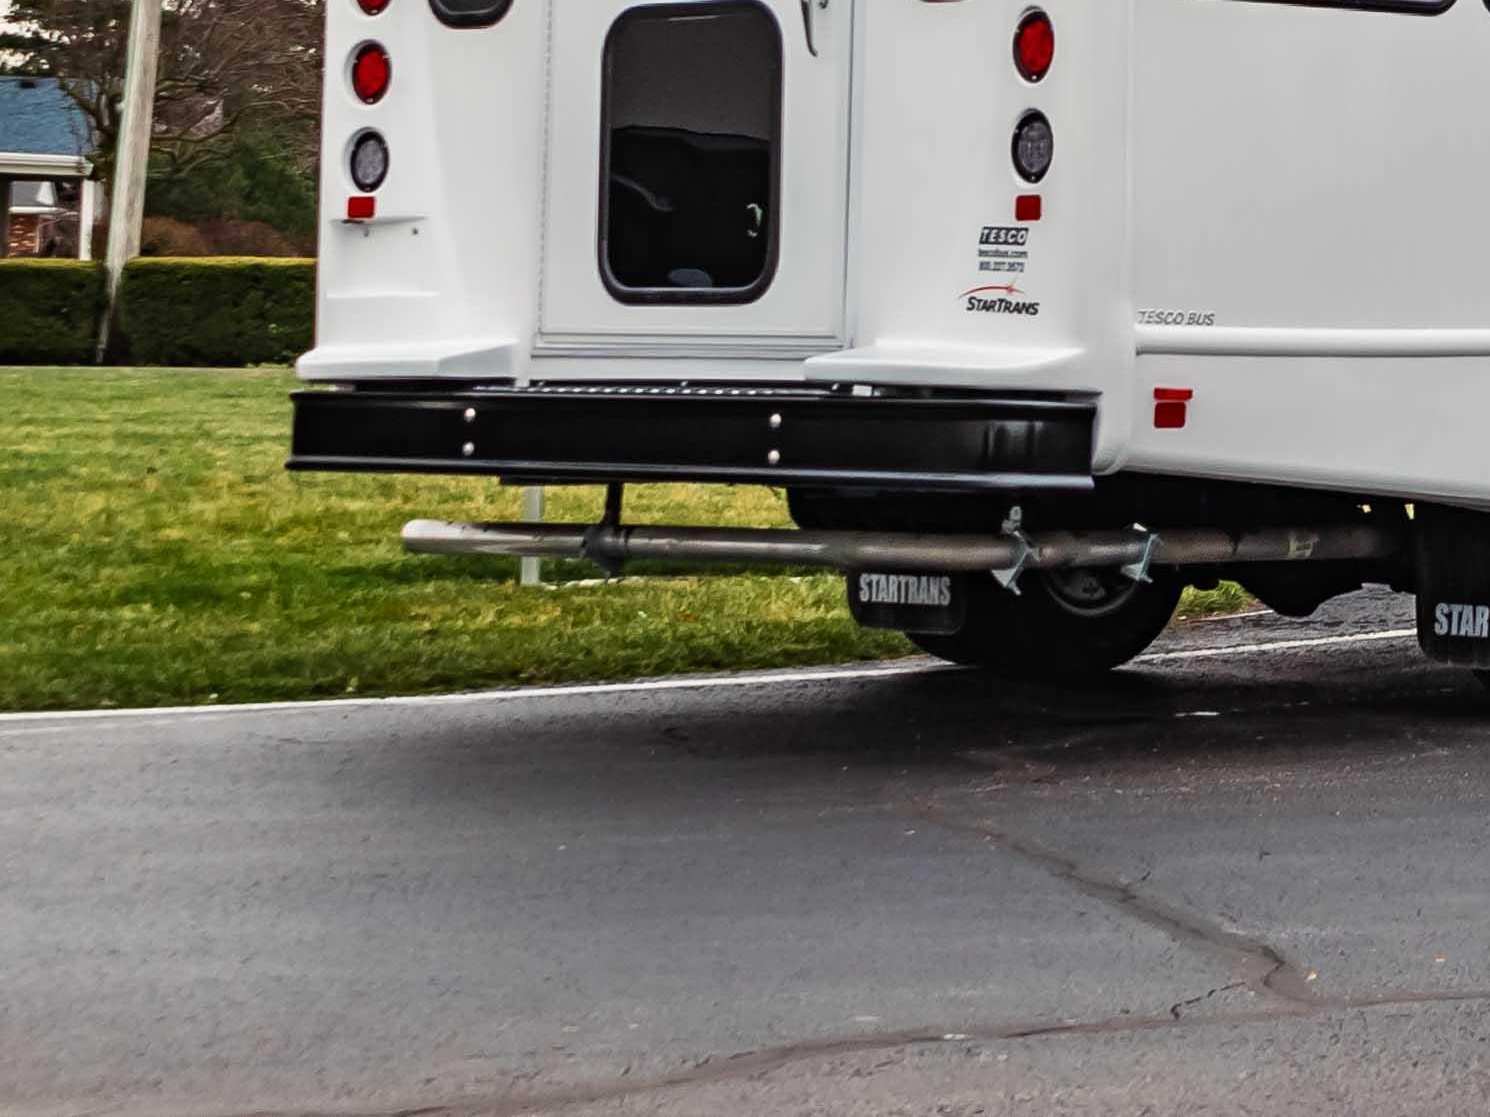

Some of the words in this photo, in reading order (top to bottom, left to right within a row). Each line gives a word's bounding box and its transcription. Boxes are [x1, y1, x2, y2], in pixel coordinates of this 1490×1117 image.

[980, 227, 1027, 245] TESCO
[1137, 310, 1185, 325] TESCO
[1186, 312, 1215, 326] BUS
[859, 573, 951, 606] STARTRANS
